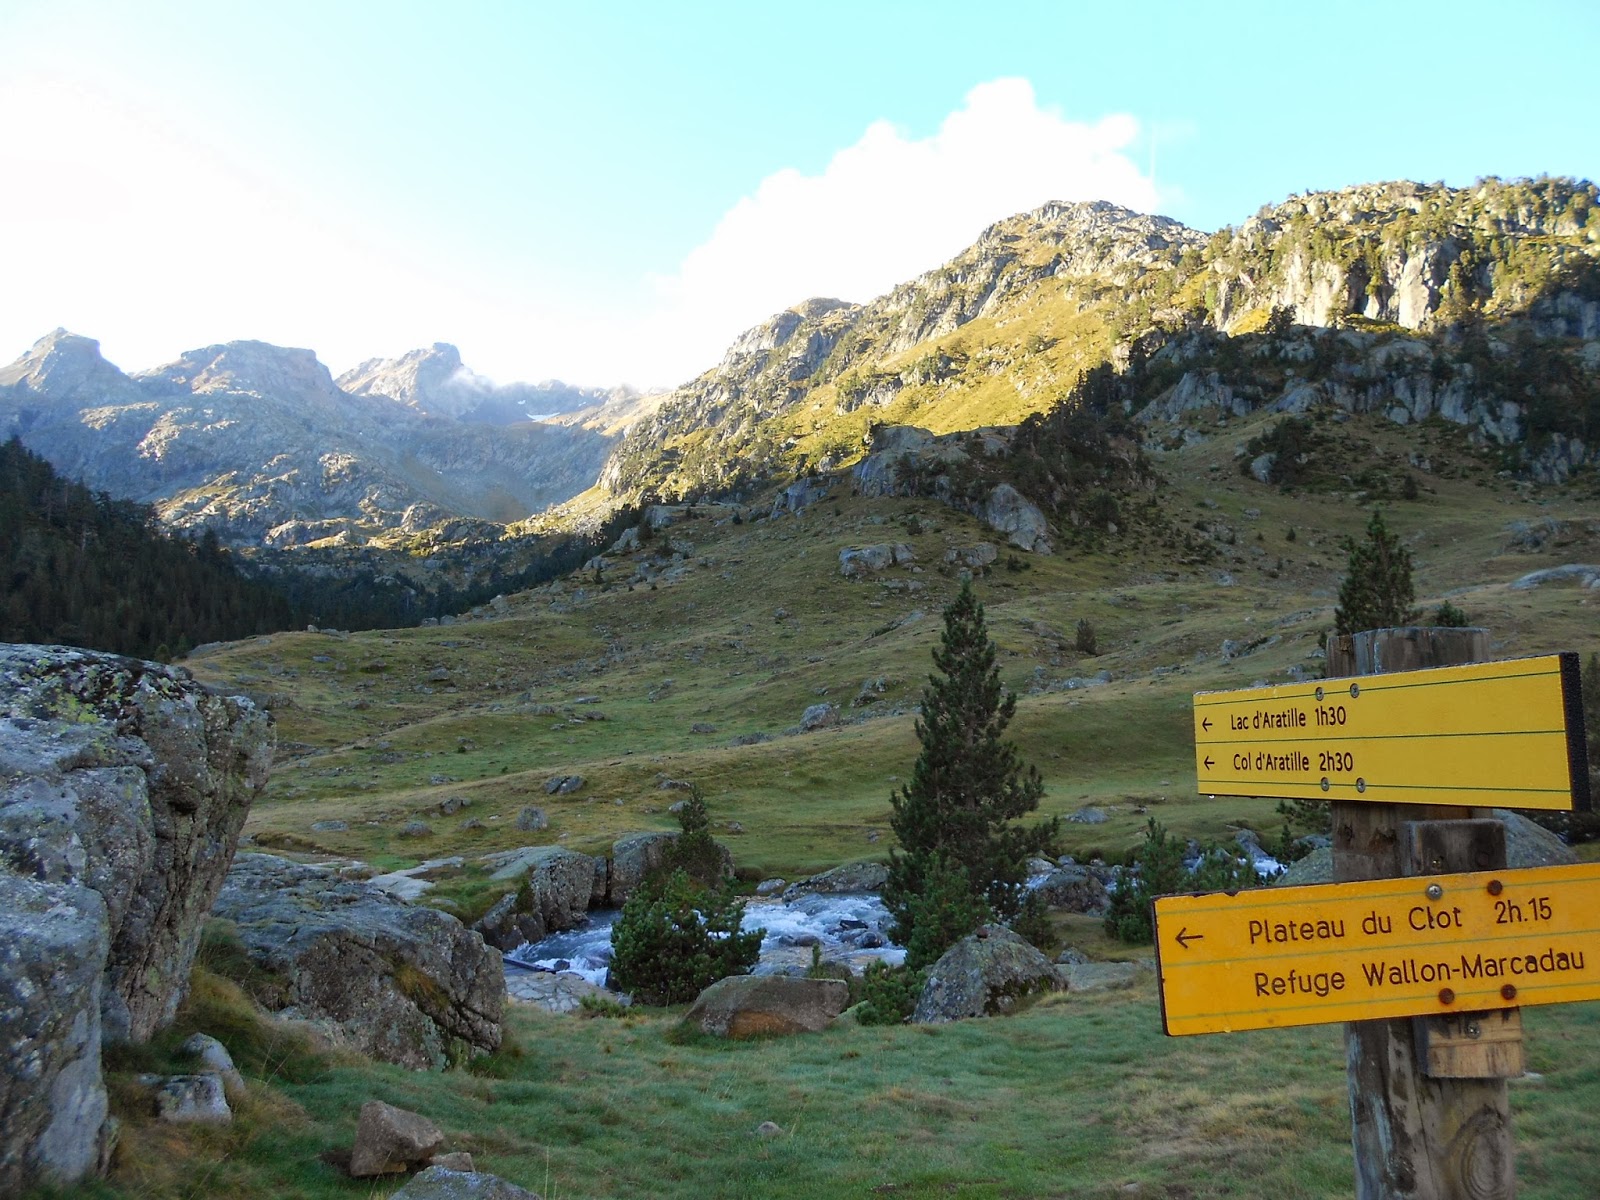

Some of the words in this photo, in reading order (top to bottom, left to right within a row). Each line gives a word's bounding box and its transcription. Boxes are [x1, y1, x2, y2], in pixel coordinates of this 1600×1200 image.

[1231, 714, 1249, 730] Lac
[1253, 708, 1306, 729] d'Aratille
[1315, 706, 1346, 726] 1h30
[1233, 752, 1252, 771] Col
[1255, 751, 1309, 771] d'Aratille
[1319, 751, 1353, 771] 2h30
[1249, 916, 1345, 944] Plateau
[1362, 911, 1392, 936] du
[1408, 906, 1462, 932] Clot
[1494, 897, 1553, 925] 2h.15
[1255, 969, 1345, 997] Refuge
[1362, 948, 1585, 986] Wallon-Marcadau
